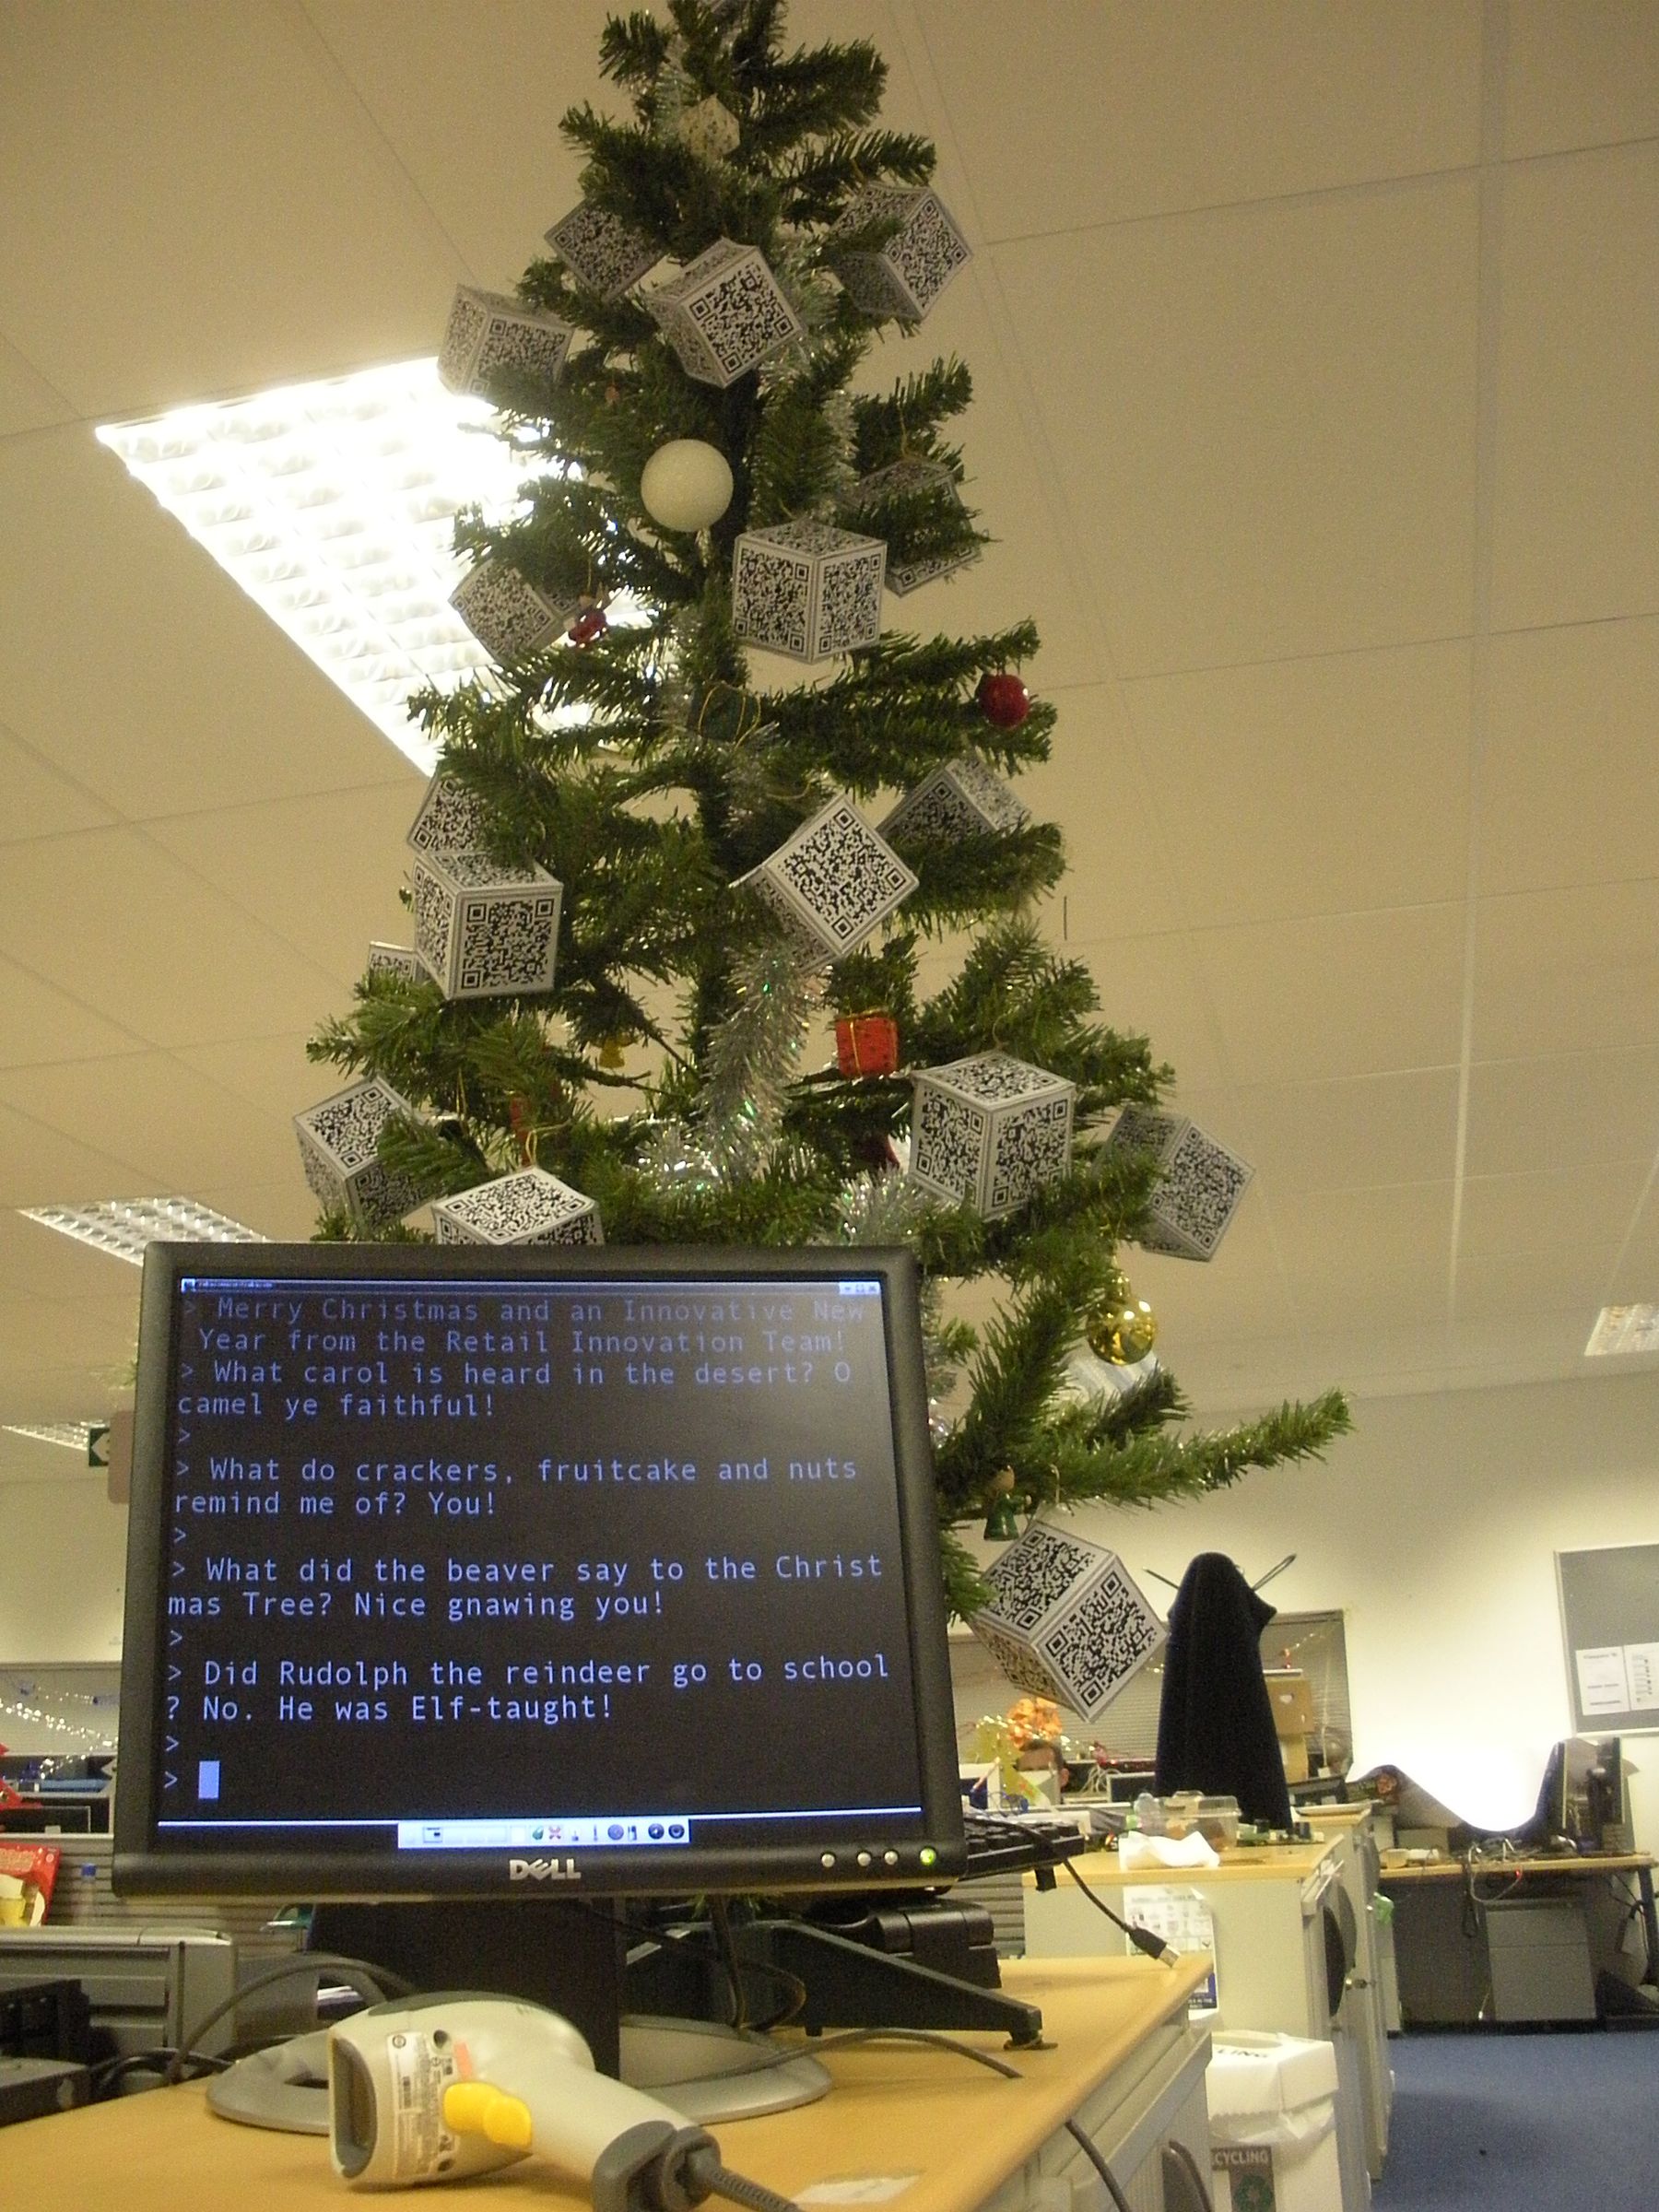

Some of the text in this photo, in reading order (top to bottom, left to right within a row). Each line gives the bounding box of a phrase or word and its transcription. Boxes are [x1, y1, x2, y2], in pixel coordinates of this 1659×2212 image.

[218, 1298, 302, 1324] Merry
[323, 1298, 477, 1322] Christmas
[500, 1300, 549, 1322] and
[571, 1304, 602, 1322] an
[624, 1300, 793, 1322] Innovative
[814, 1300, 865, 1322] New
[199, 1328, 843, 1354] Year from the Retail Innovation Team!
[214, 1360, 282, 1382] What
[304, 1361, 388, 1383] carol
[414, 1362, 442, 1383] is
[465, 1362, 550, 1384] heard
[575, 1363, 604, 1384] in
[625, 1362, 674, 1383] the
[695, 1361, 814, 1383] desert?
[178, 1393, 494, 1420] camel ye faithful!
[210, 1457, 279, 1480] What
[301, 1458, 335, 1481] do
[356, 1458, 512, 1485] crackers,
[538, 1458, 697, 1482] fruitcake
[719, 1458, 769, 1480] and
[789, 1457, 857, 1479] nuts
[175, 1491, 495, 1515] remind me of? You!
[206, 1557, 277, 1582] What
[300, 1558, 352, 1582] did
[375, 1558, 426, 1582] the
[448, 1558, 555, 1582] beaver
[577, 1562, 628, 1586] say
[651, 1558, 684, 1581] to
[705, 1556, 758, 1579] the
[776, 1554, 882, 1578] Christ
[168, 1591, 663, 1621] mas Tree? Nice gnawing you!
[205, 1660, 258, 1685] Did
[279, 1661, 408, 1691] Rudolph
[430, 1661, 482, 1685] the
[506, 1660, 650, 1685] reindeer
[673, 1663, 708, 1688] go
[729, 1658, 762, 1681] to
[783, 1653, 888, 1679] school
[203, 1696, 252, 1721] No.
[279, 1696, 313, 1720] He
[335, 1701, 388, 1720] was
[412, 1694, 612, 1724] Elf-taught!
[510, 1858, 582, 1881] DELL
